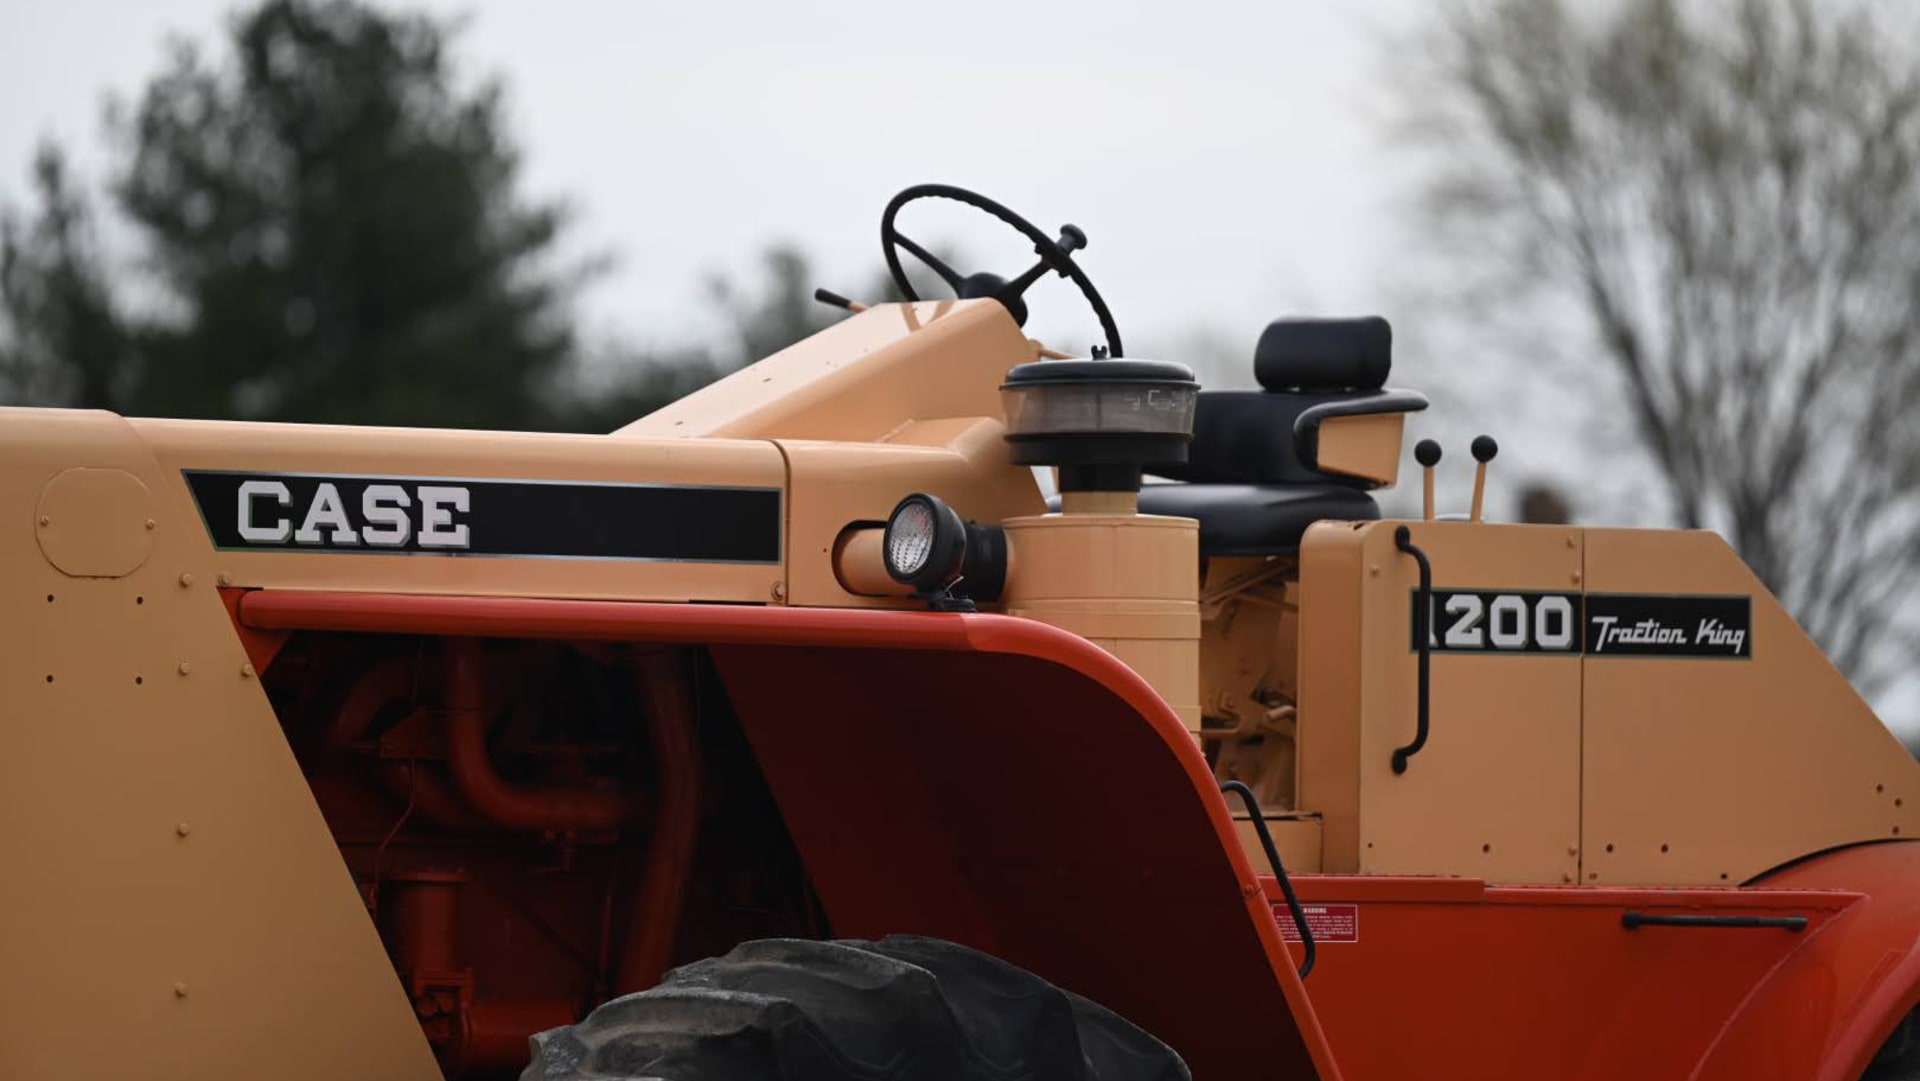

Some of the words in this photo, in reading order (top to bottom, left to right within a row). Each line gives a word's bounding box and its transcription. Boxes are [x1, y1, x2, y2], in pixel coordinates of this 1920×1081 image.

[238, 480, 470, 548] CASE
[1591, 616, 1688, 652] Traction
[1695, 618, 1746, 654] King
